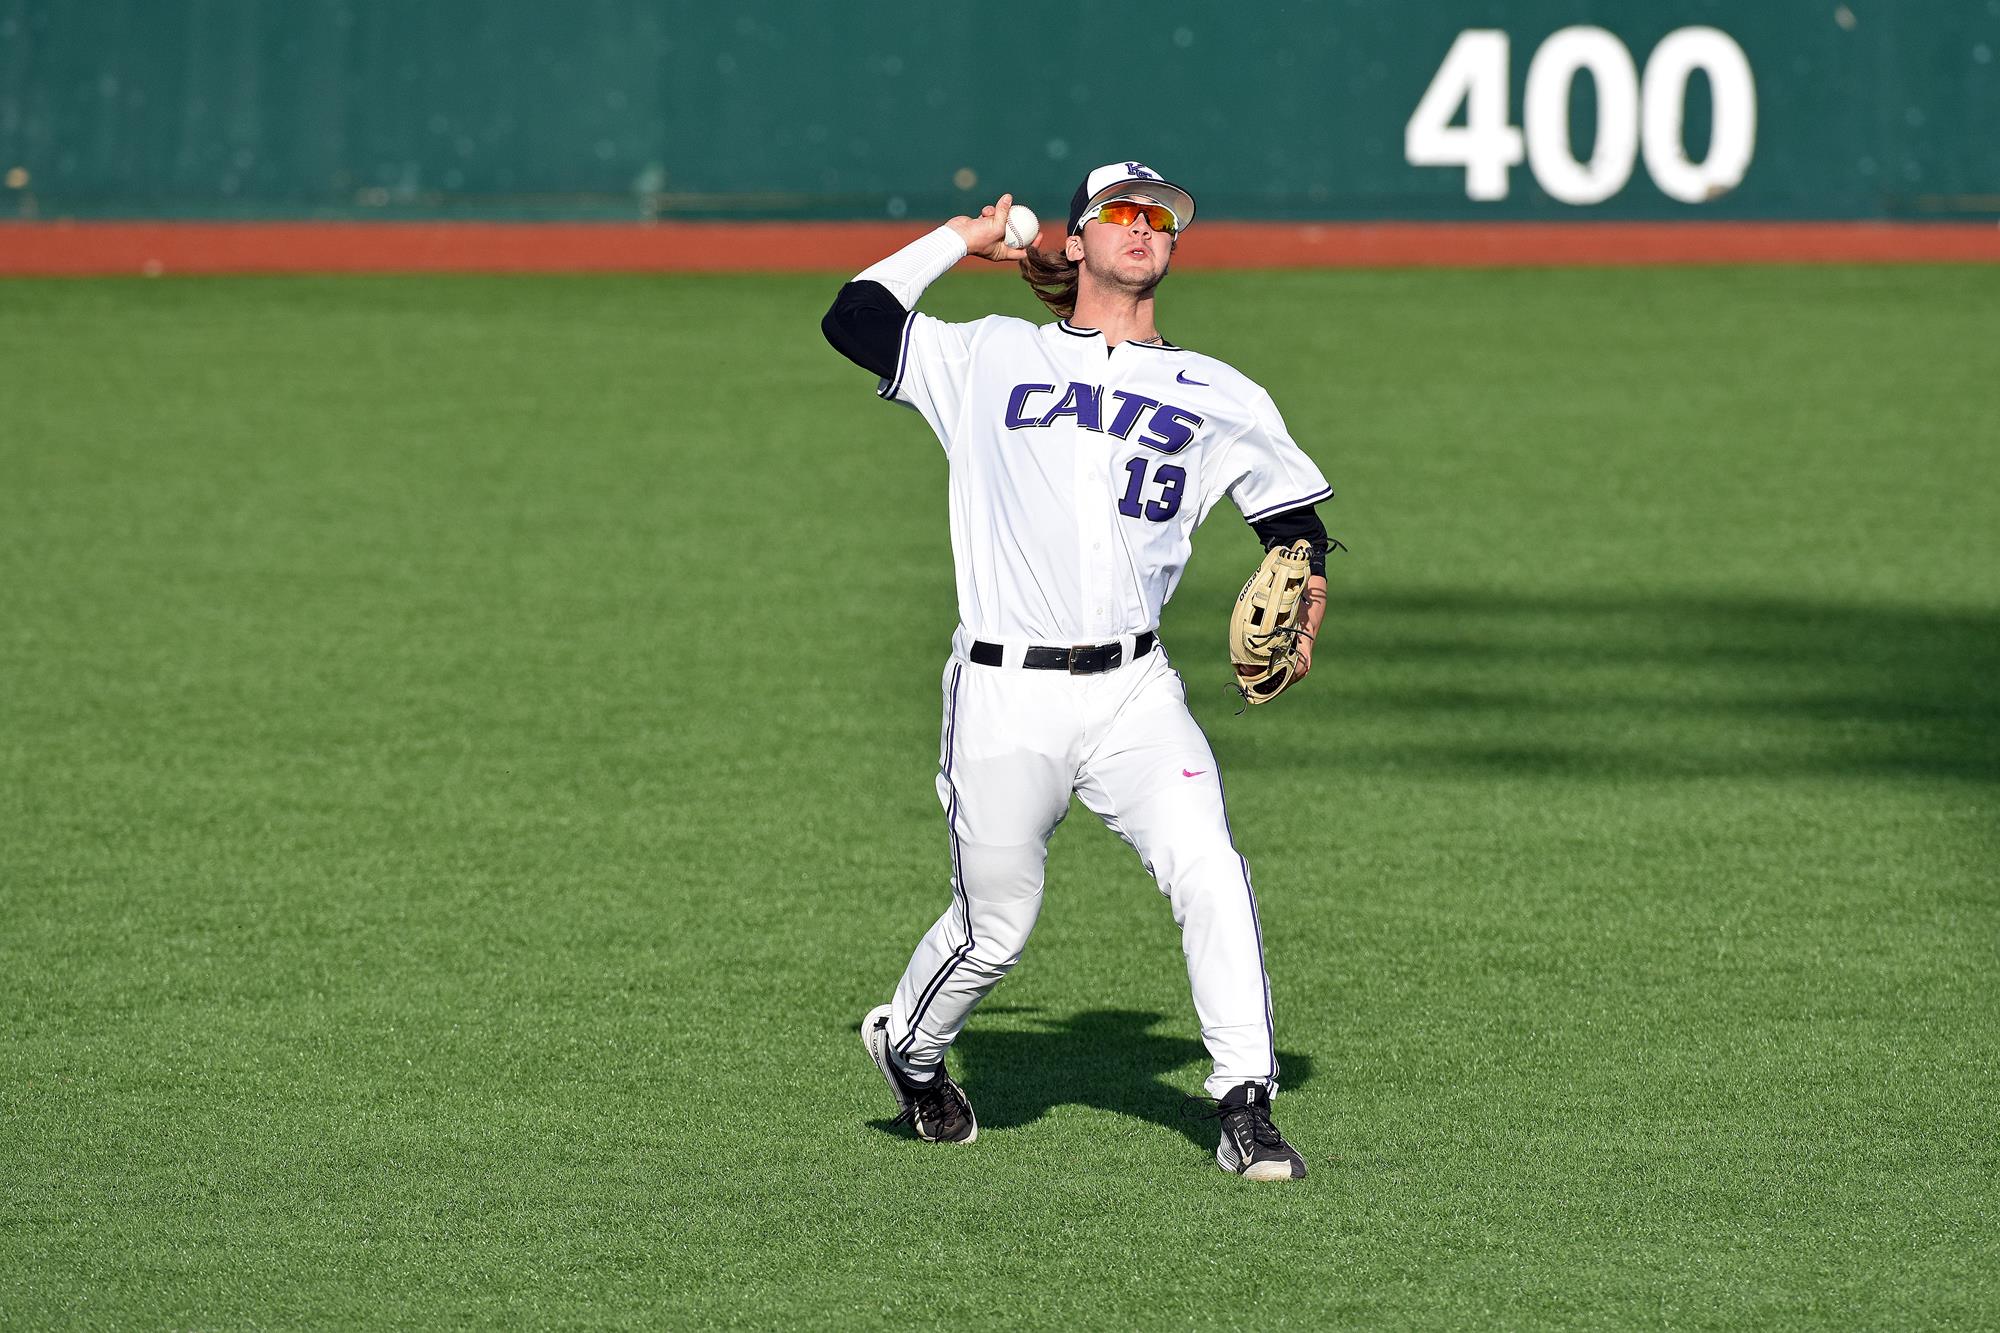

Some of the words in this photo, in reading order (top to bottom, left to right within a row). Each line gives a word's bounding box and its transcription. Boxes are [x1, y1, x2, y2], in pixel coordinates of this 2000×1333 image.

[1405, 25, 1757, 205] 400
[1005, 382, 1204, 455] CATS
[1118, 457, 1187, 522] 13
